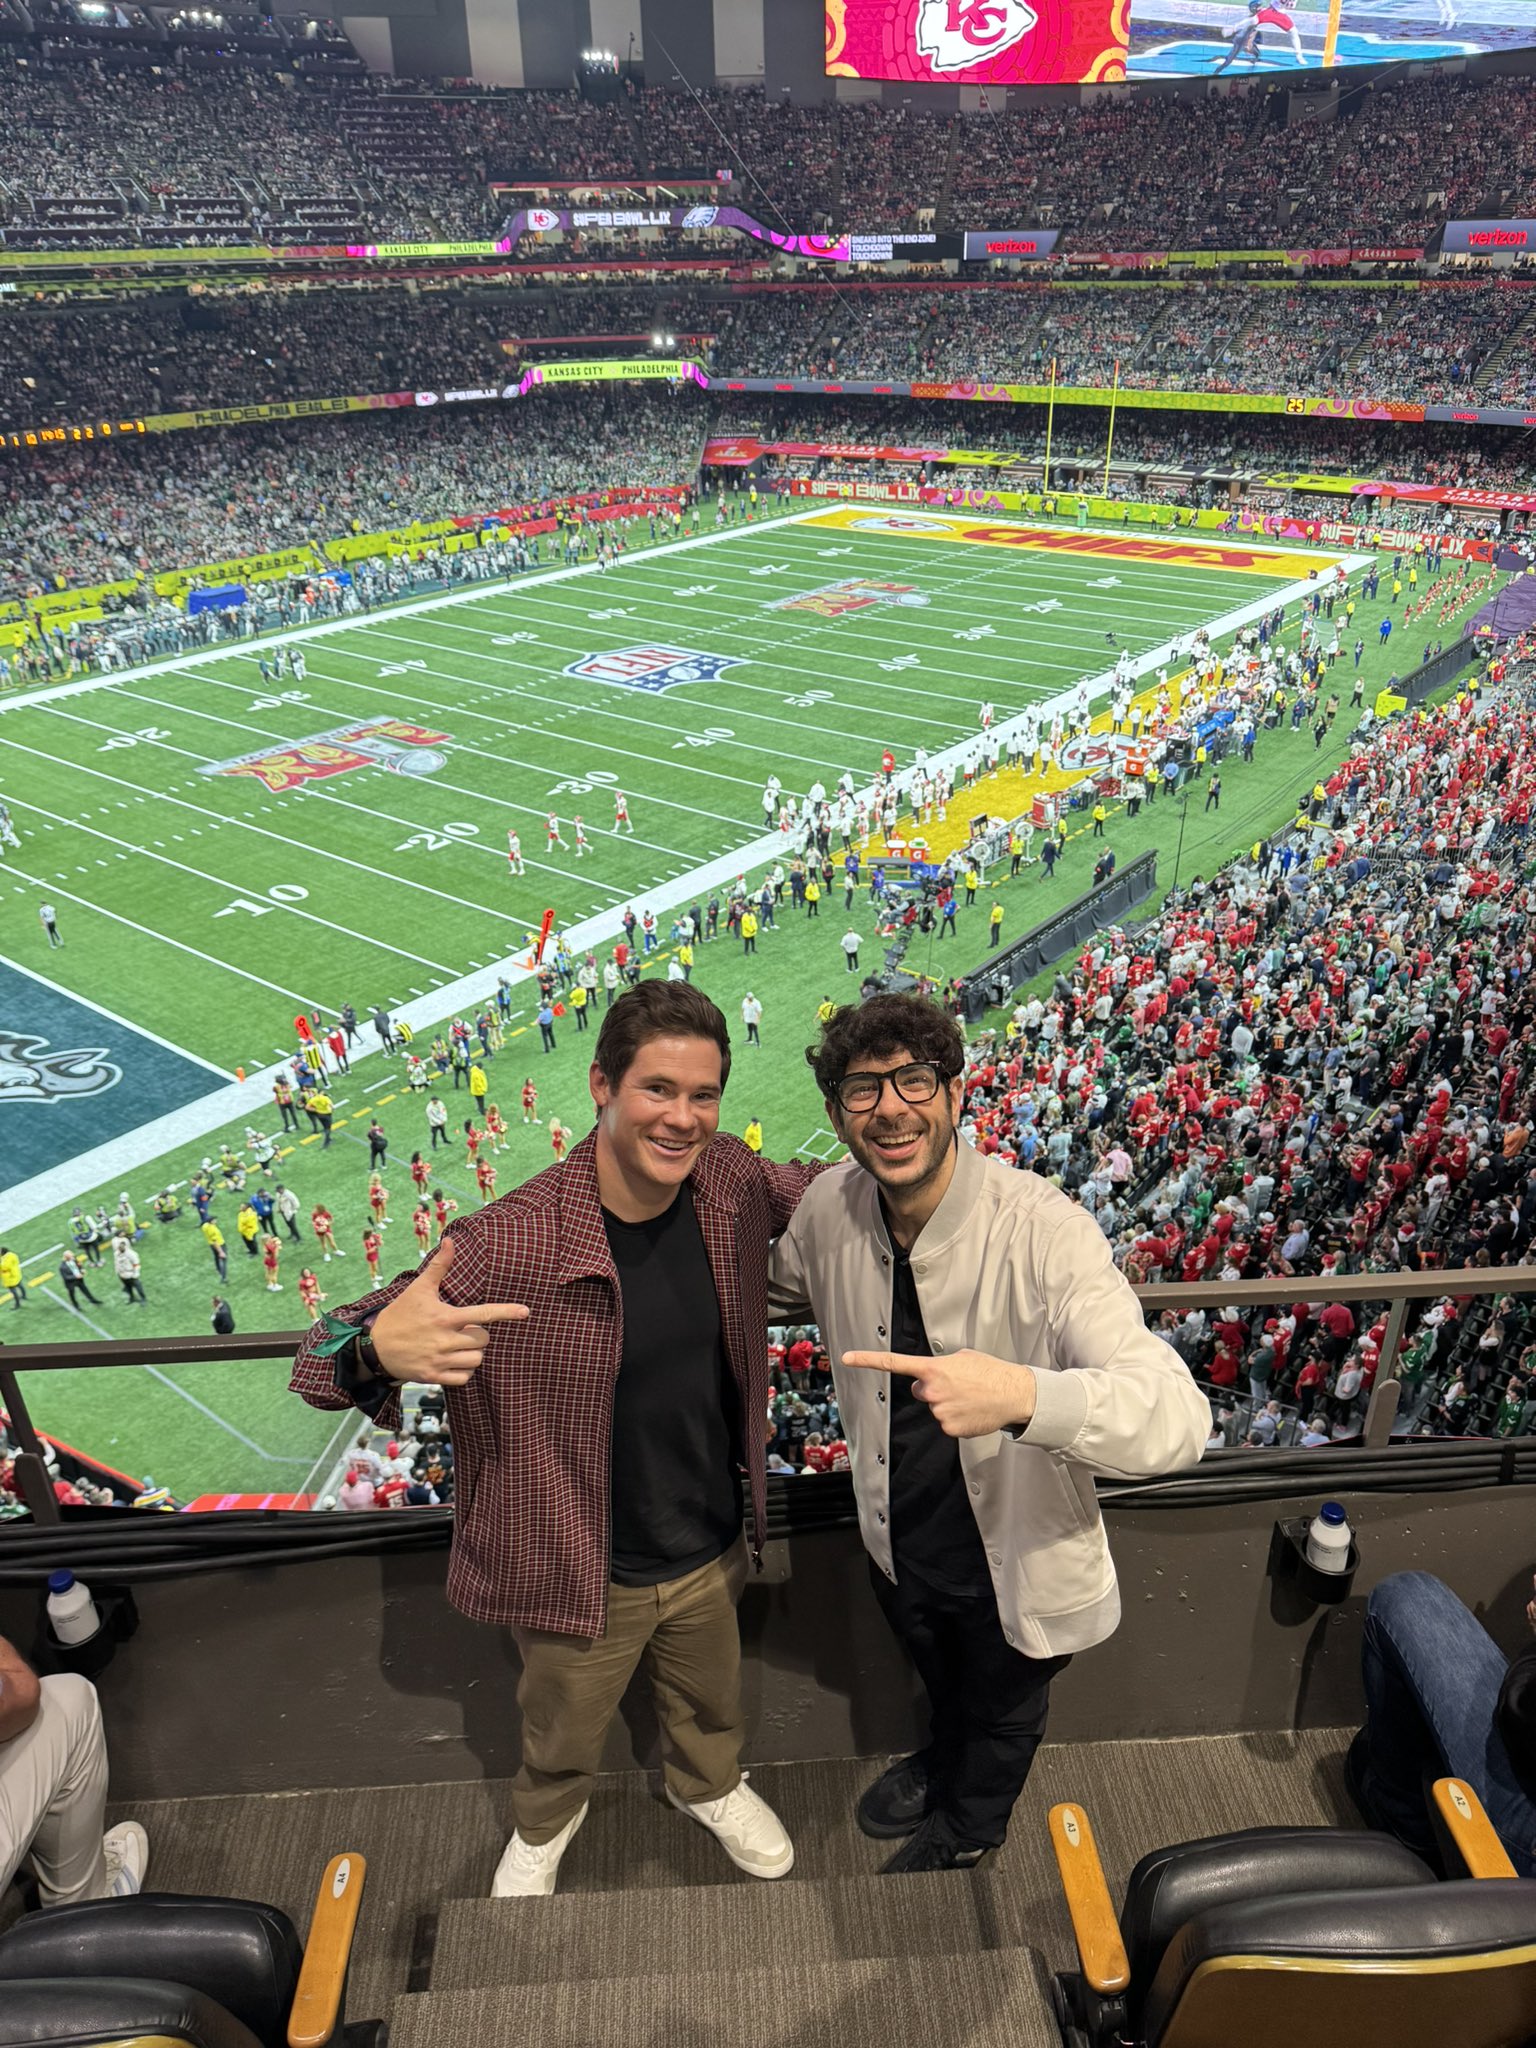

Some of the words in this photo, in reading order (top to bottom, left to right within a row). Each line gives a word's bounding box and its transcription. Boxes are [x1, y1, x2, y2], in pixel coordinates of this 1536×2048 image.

[945, 0, 1008, 46] KC
[573, 212, 612, 226] SUPER
[613, 212, 650, 226] BOWL
[650, 211, 671, 225] LIX
[1468, 228, 1527, 246] verizon
[986, 239, 1037, 254] verizon
[548, 367, 581, 377] KANSAS
[583, 367, 603, 376] CITY
[622, 364, 678, 375] PHILADELPHIA
[195, 404, 291, 425] PHILADELPHIA
[296, 399, 350, 414] EAGLES
[1287, 399, 1304, 413] 25
[1030, 455, 1103, 468] SUPER
[1105, 459, 1196, 476] BOWL
[1201, 468, 1261, 481] LIX
[856, 484, 896, 499] BOWL
[898, 487, 921, 501] LIX
[1441, 494, 1526, 508] SUPERDOME
[1446, 490, 1536, 503] CAESARS
[963, 528, 1283, 567] CHIEFS
[380, 659, 428, 675] 40
[582, 649, 692, 677] NFL
[878, 654, 921, 672] 40
[252, 690, 312, 709] 30
[783, 689, 835, 708] 50
[106, 726, 172, 749] 20
[684, 727, 736, 748] 40
[556, 770, 620, 796] 30
[408, 821, 480, 851] 20
[228, 884, 310, 918] 10
[1455, 1796, 1466, 1806] A2
[1066, 1822, 1077, 1833] A3
[337, 1872, 346, 1884] A4
